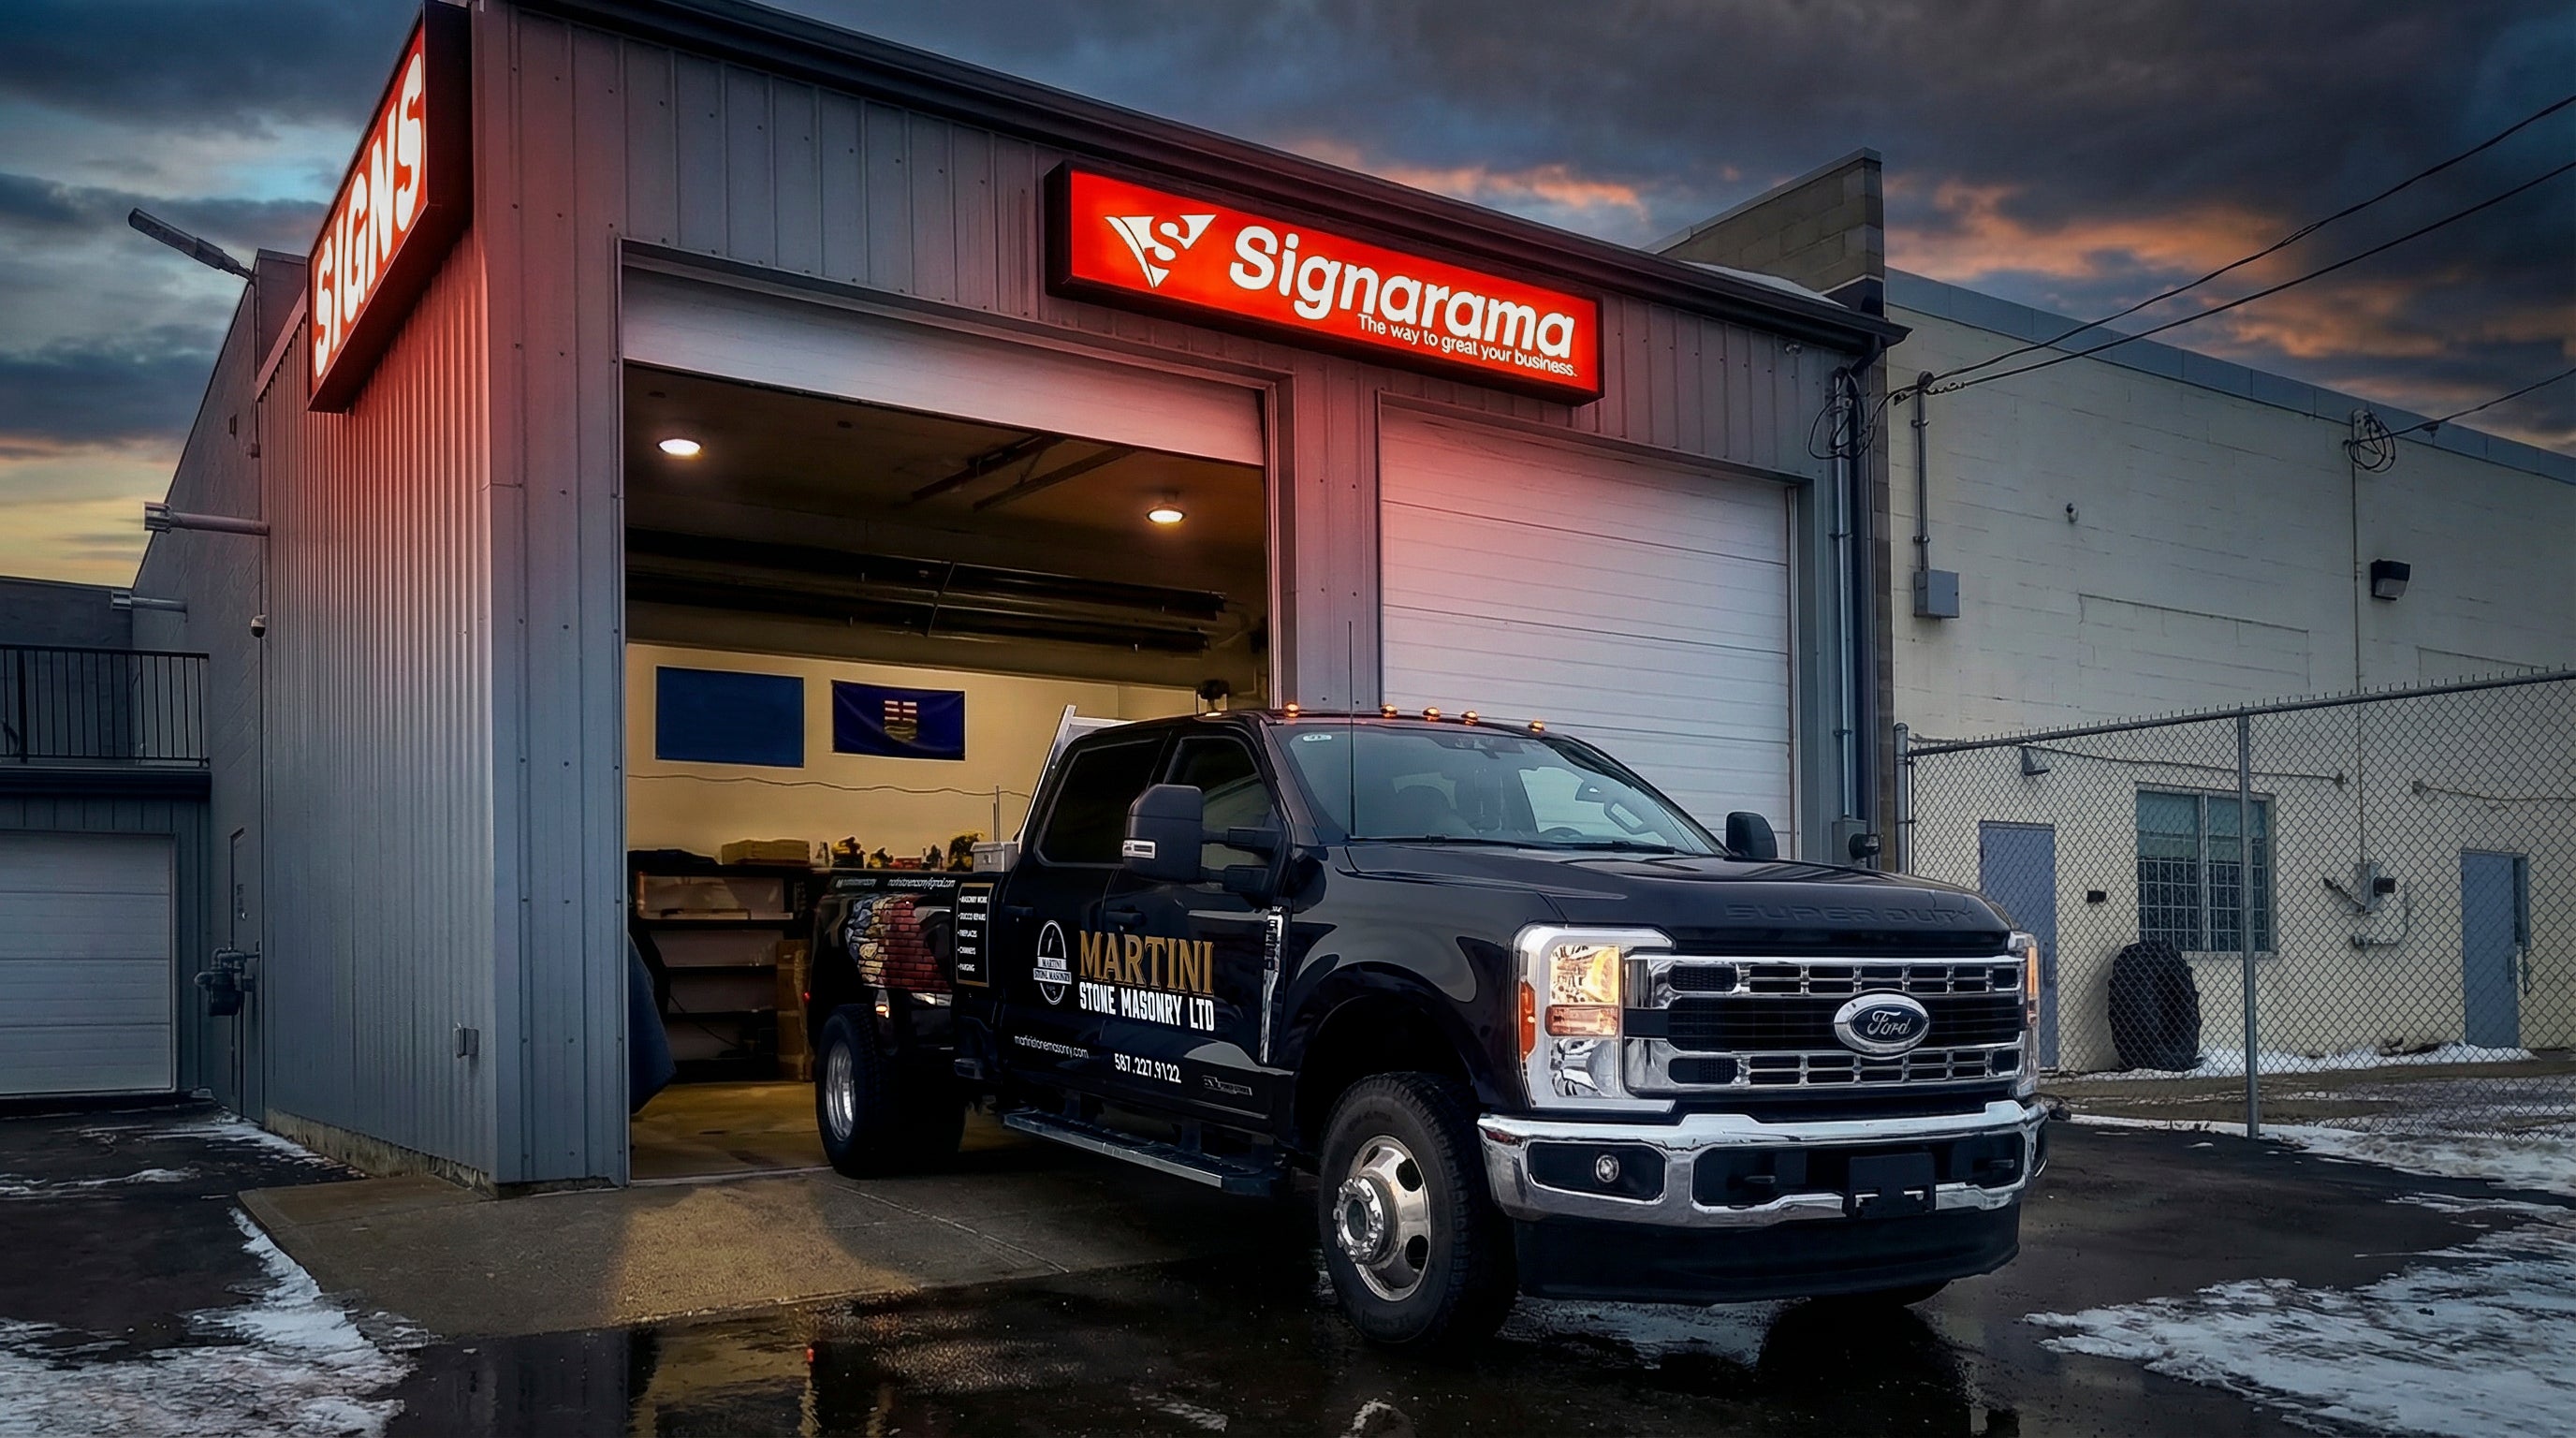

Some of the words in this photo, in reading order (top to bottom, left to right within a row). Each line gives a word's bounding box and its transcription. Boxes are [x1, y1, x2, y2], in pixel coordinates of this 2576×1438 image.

[315, 53, 421, 377] SIGNS
[1229, 226, 1574, 359] Signarama
[1357, 313, 1385, 334] The
[1390, 325, 1420, 345] way
[1424, 330, 1438, 346] to
[1442, 335, 1478, 353] great
[1481, 344, 1512, 362] your
[1515, 350, 1578, 376] business.
[1726, 903, 1879, 922] SUPER
[1883, 907, 1973, 925] DUTY
[1041, 958, 1062, 969] MARTINI
[1079, 930, 1214, 997] MARTINI
[1079, 981, 1116, 1016] STONE
[1120, 987, 1182, 1026] MASONRY
[1189, 997, 1215, 1032] LTD
[1866, 1010, 1911, 1035] Ford
[1114, 1052, 1182, 1083] 587.227.9122
